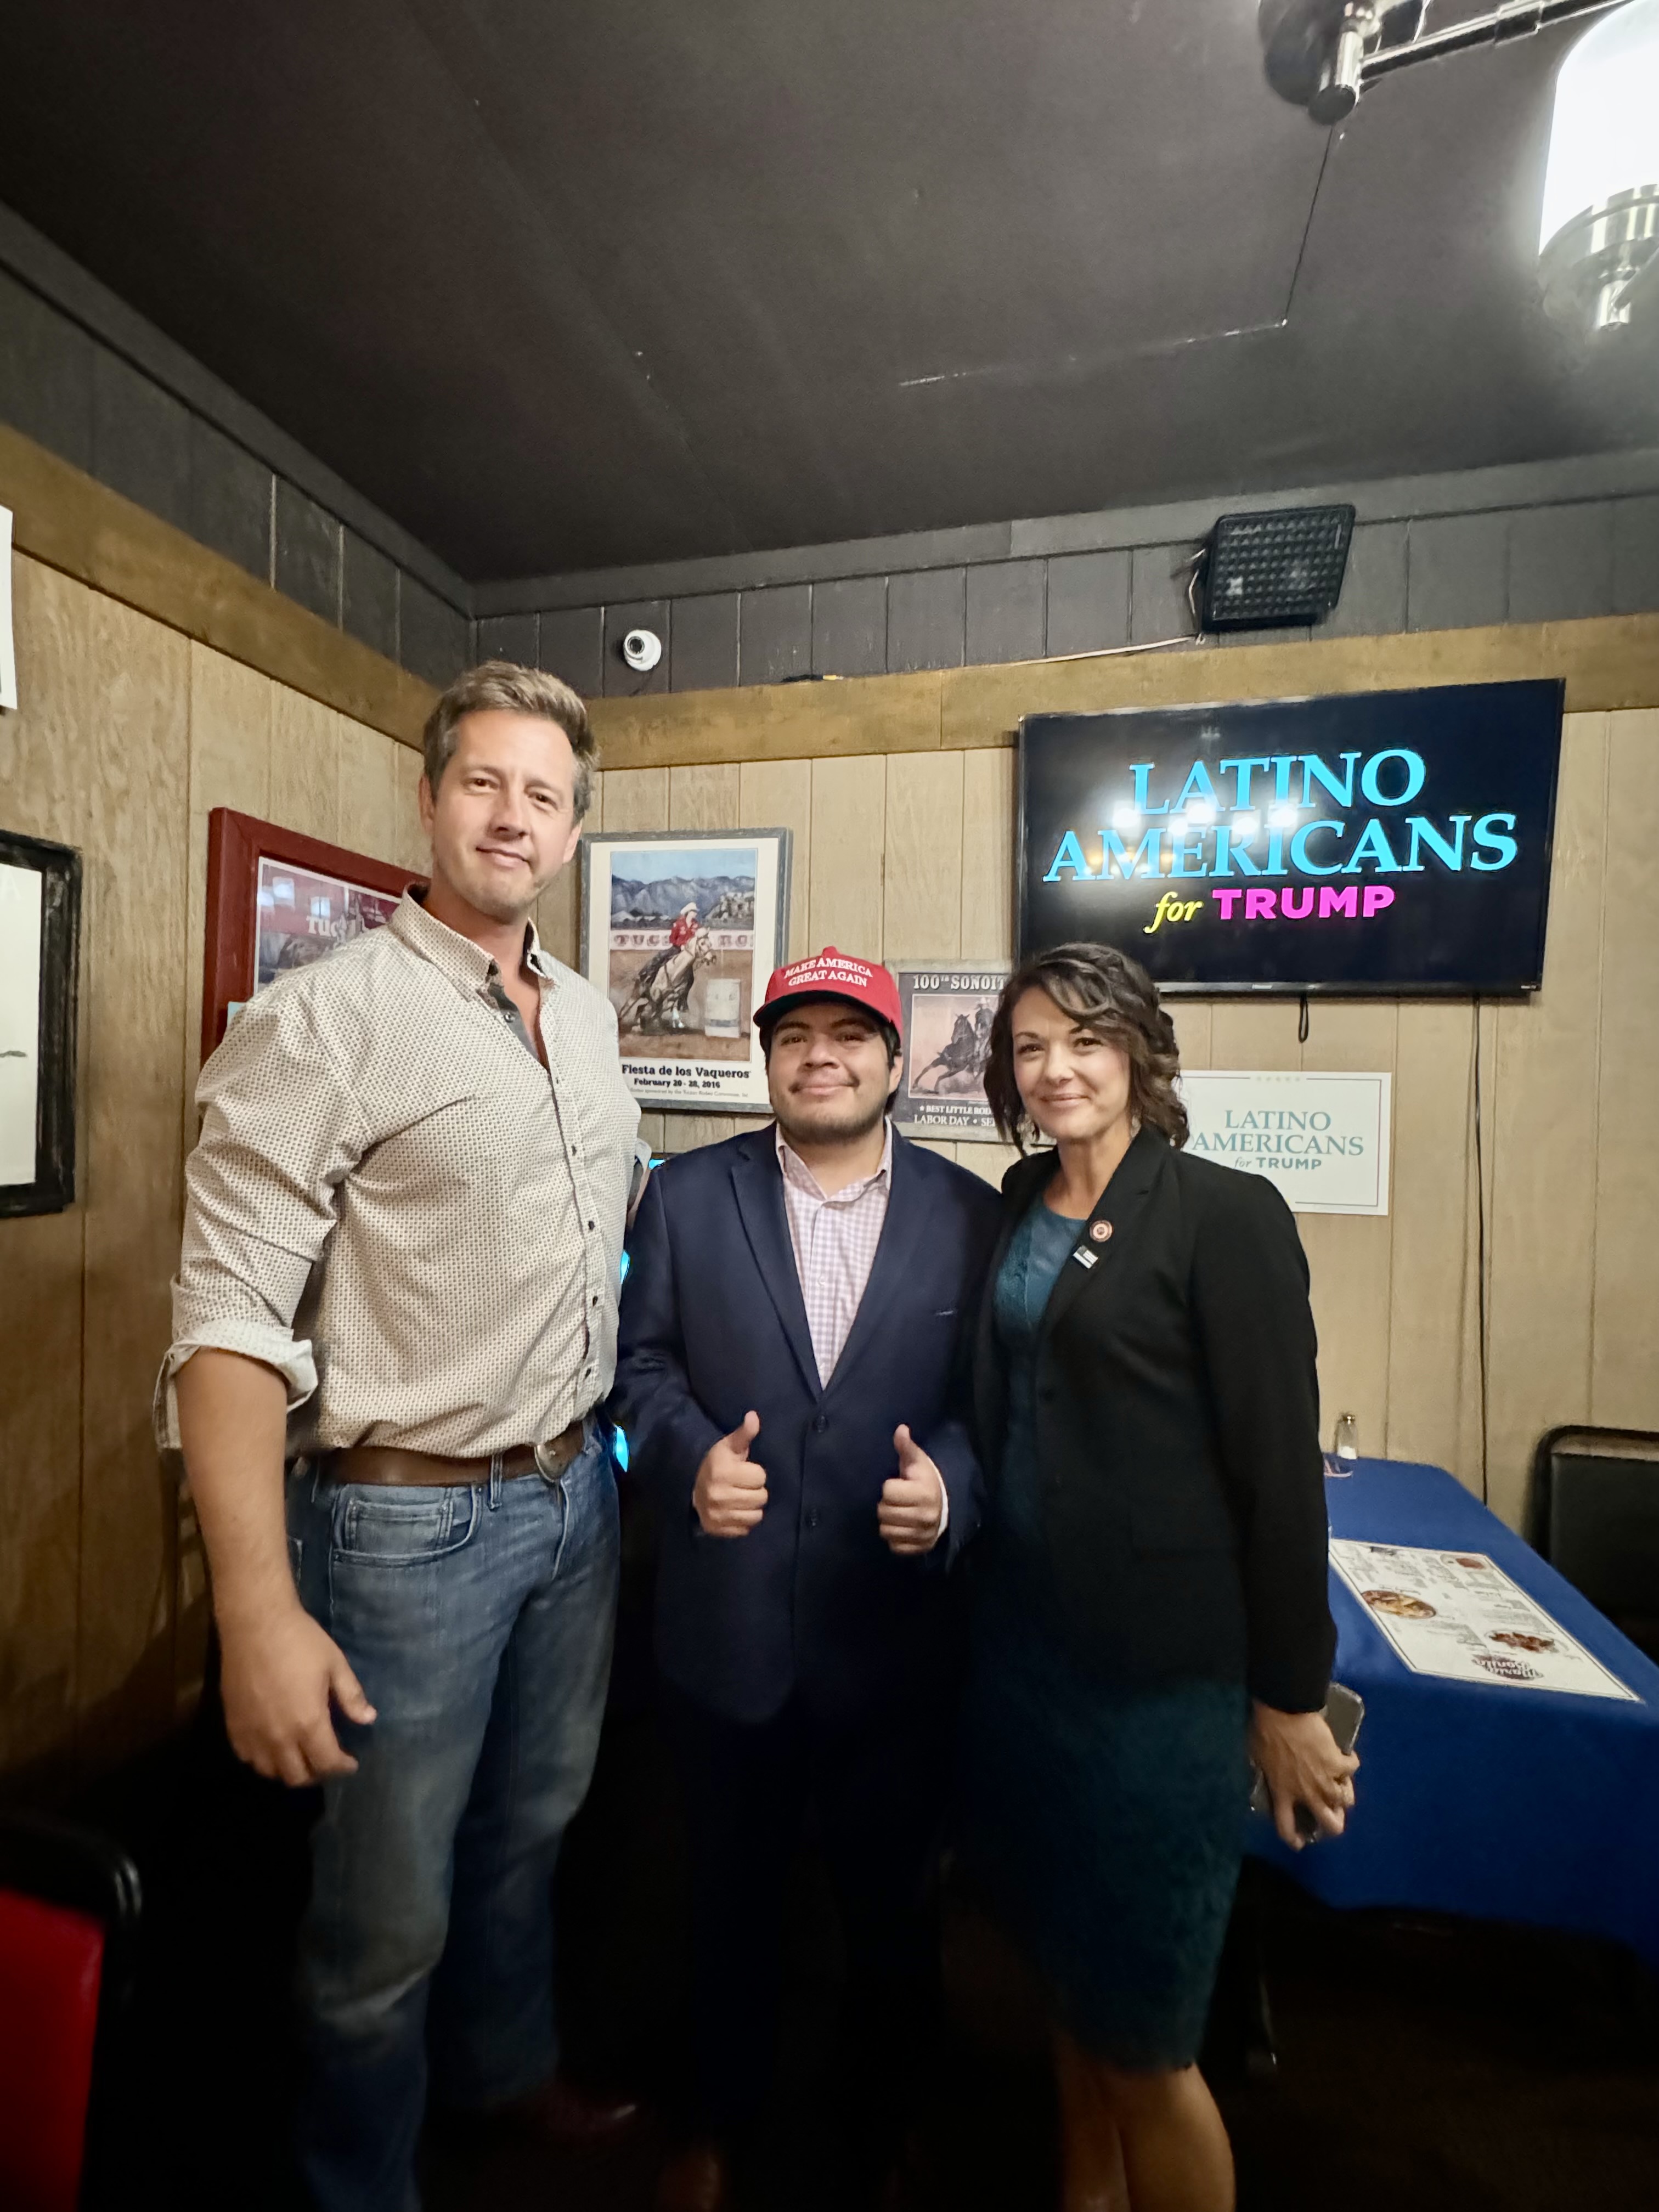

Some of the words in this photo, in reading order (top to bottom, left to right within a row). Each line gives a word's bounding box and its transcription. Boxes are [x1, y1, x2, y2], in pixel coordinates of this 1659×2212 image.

[1128, 748, 1426, 816] LATINO
[1042, 813, 1518, 883] AMERICANS
[1143, 890, 1204, 934] for
[1212, 884, 1395, 921] TRUMP
[784, 960, 816, 979] MAKE
[816, 957, 873, 978] AMERICA
[788, 970, 827, 986] GREAT
[828, 970, 867, 987] AGAIN
[621, 1064, 656, 1075] Fiesta
[659, 1065, 673, 1076] de
[675, 1066, 692, 1076] los
[695, 1067, 750, 1079] Vaqueros
[634, 1077, 670, 1088] February
[946, 1106, 973, 1114] LITTLE
[914, 1114, 947, 1125] LABOR
[949, 1116, 969, 1126] DAY
[1224, 1109, 1331, 1131] LATINO
[1192, 1132, 1364, 1156] AMERICANS
[1234, 1156, 1252, 1169] for
[1255, 1156, 1322, 1170] TRUMP
